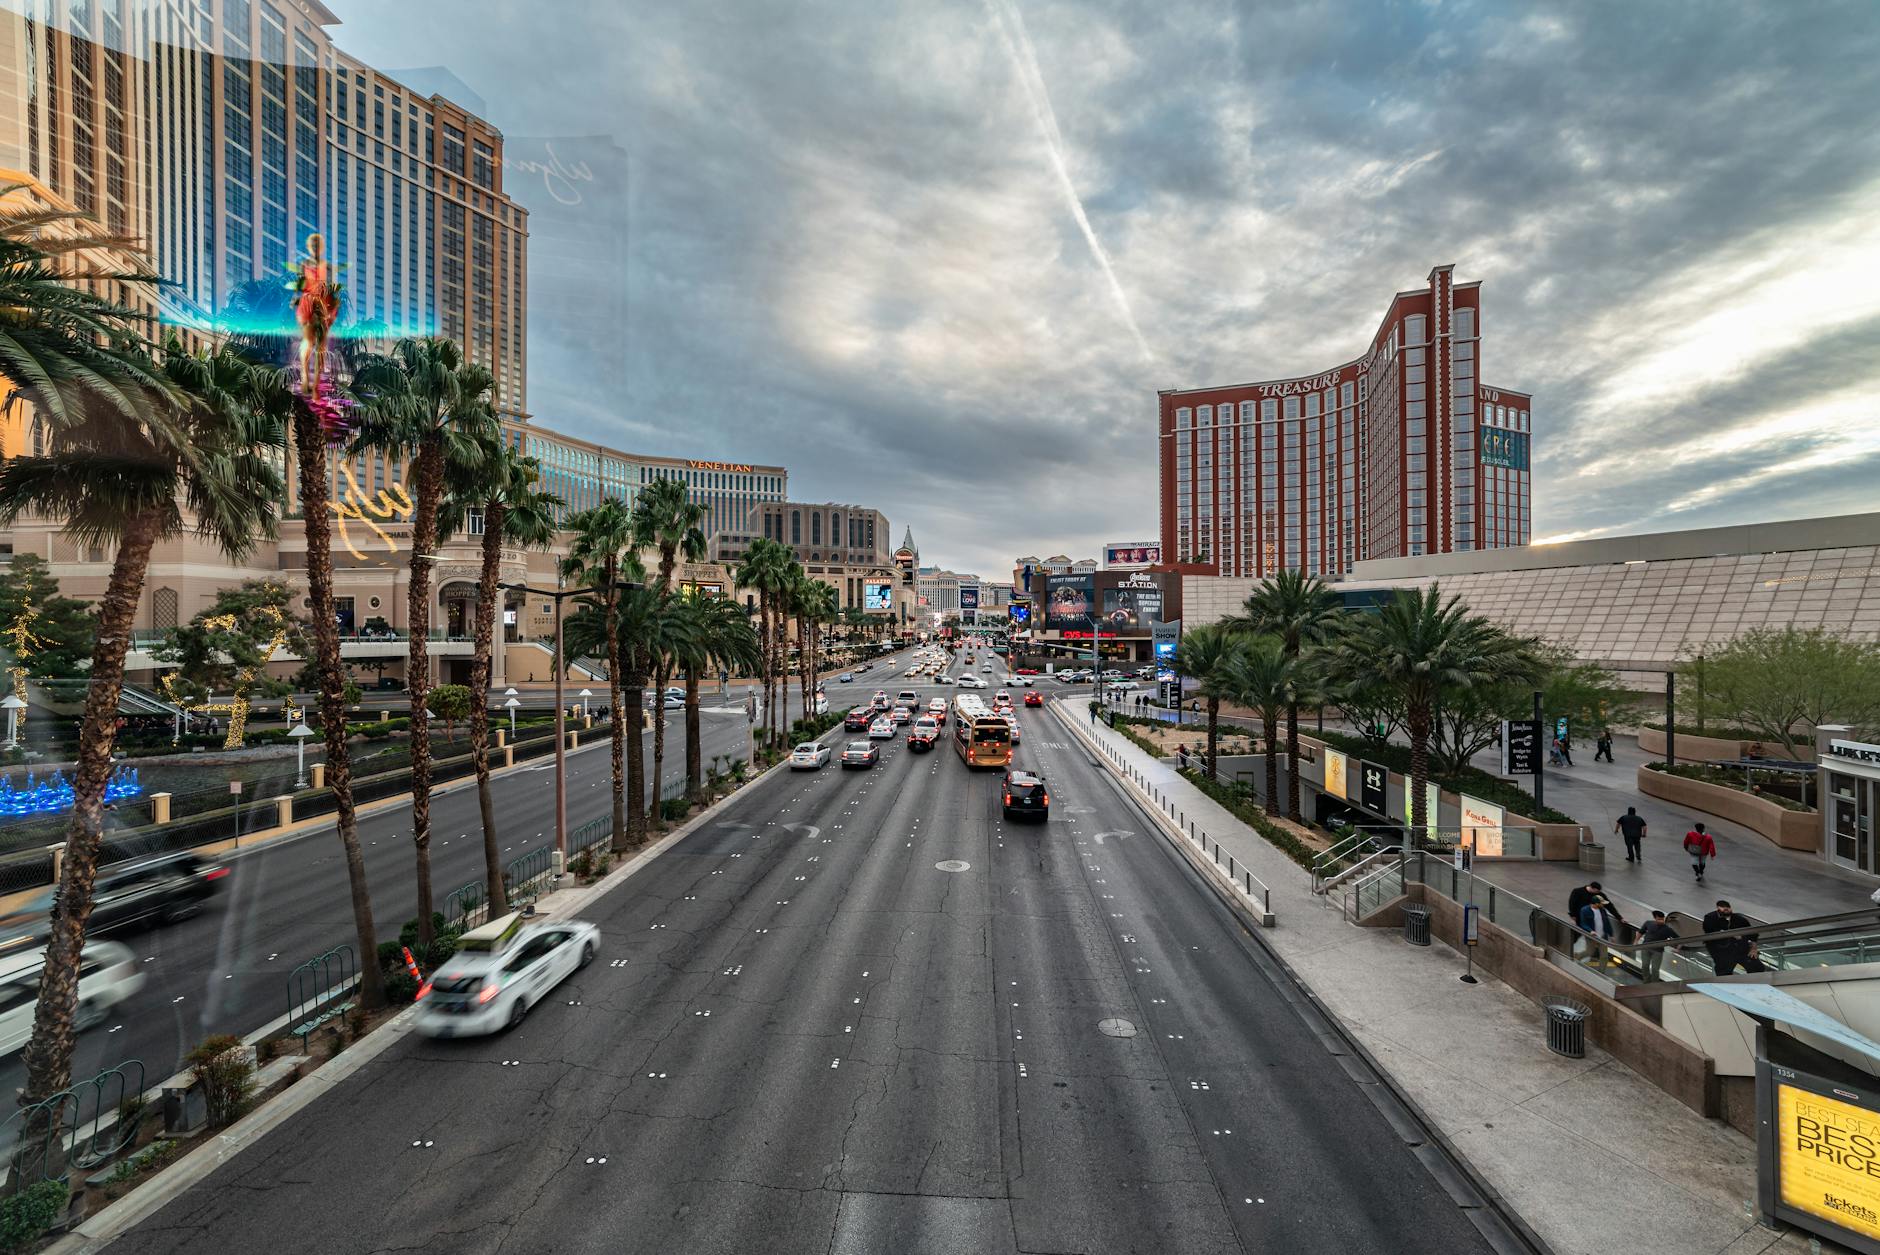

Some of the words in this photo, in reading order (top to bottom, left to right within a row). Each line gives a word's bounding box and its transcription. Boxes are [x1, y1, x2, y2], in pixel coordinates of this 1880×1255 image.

[1260, 371, 1340, 397] TREASURE
[689, 460, 751, 472] VENETIAN
[1064, 631, 1081, 639] CVS
[1796, 1101, 1841, 1126] BEST
[1824, 1193, 1877, 1219] tickets
